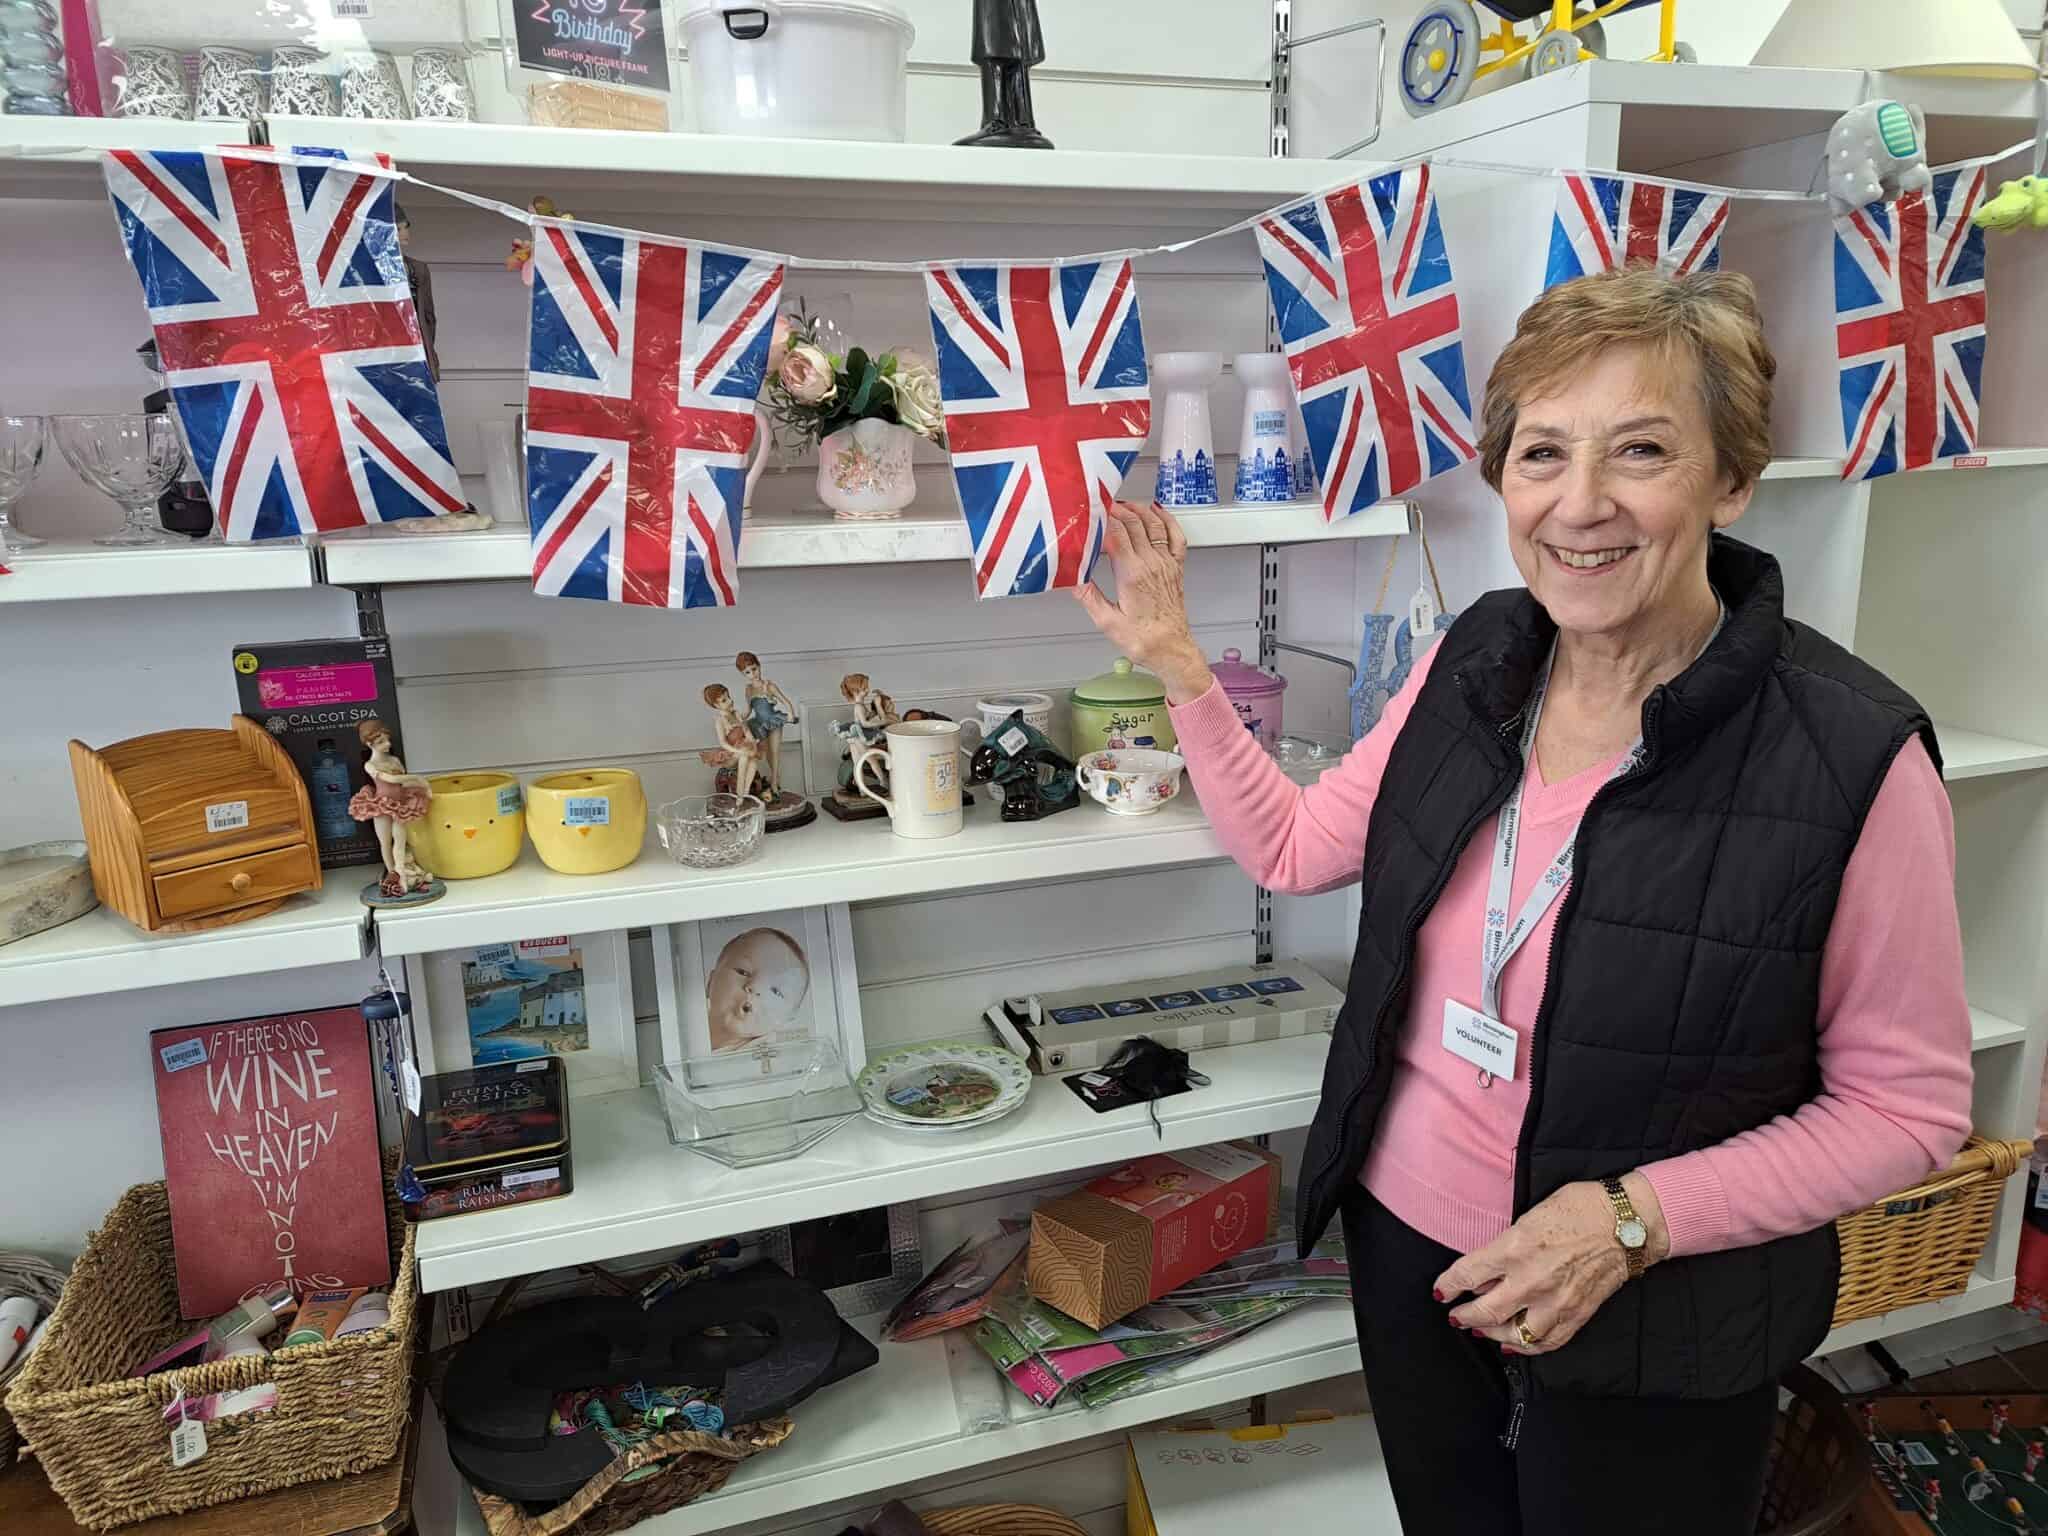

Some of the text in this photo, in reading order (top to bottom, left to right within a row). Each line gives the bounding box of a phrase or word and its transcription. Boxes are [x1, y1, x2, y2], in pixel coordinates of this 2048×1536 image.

[552, 8, 632, 55] Birthday
[542, 47, 649, 74] LIGHT-UP PICTURE FRAME
[288, 708, 379, 726] CALCOT SPA
[1112, 712, 1154, 728] Sugar
[1503, 808, 1517, 868] Birmingham
[208, 1031, 223, 1059] IF
[228, 1023, 288, 1056] THERE'S
[288, 1020, 319, 1050] NO
[1455, 1026, 1502, 1056] VOLUNTEER
[206, 1049, 338, 1115] WINE
[452, 1084, 500, 1099] RUM
[255, 1106, 290, 1134] IN
[205, 1111, 338, 1176] HEAVEN
[252, 1175, 298, 1206] I'M
[458, 1190, 518, 1210] RAISINS
[463, 1184, 495, 1198] RUM
